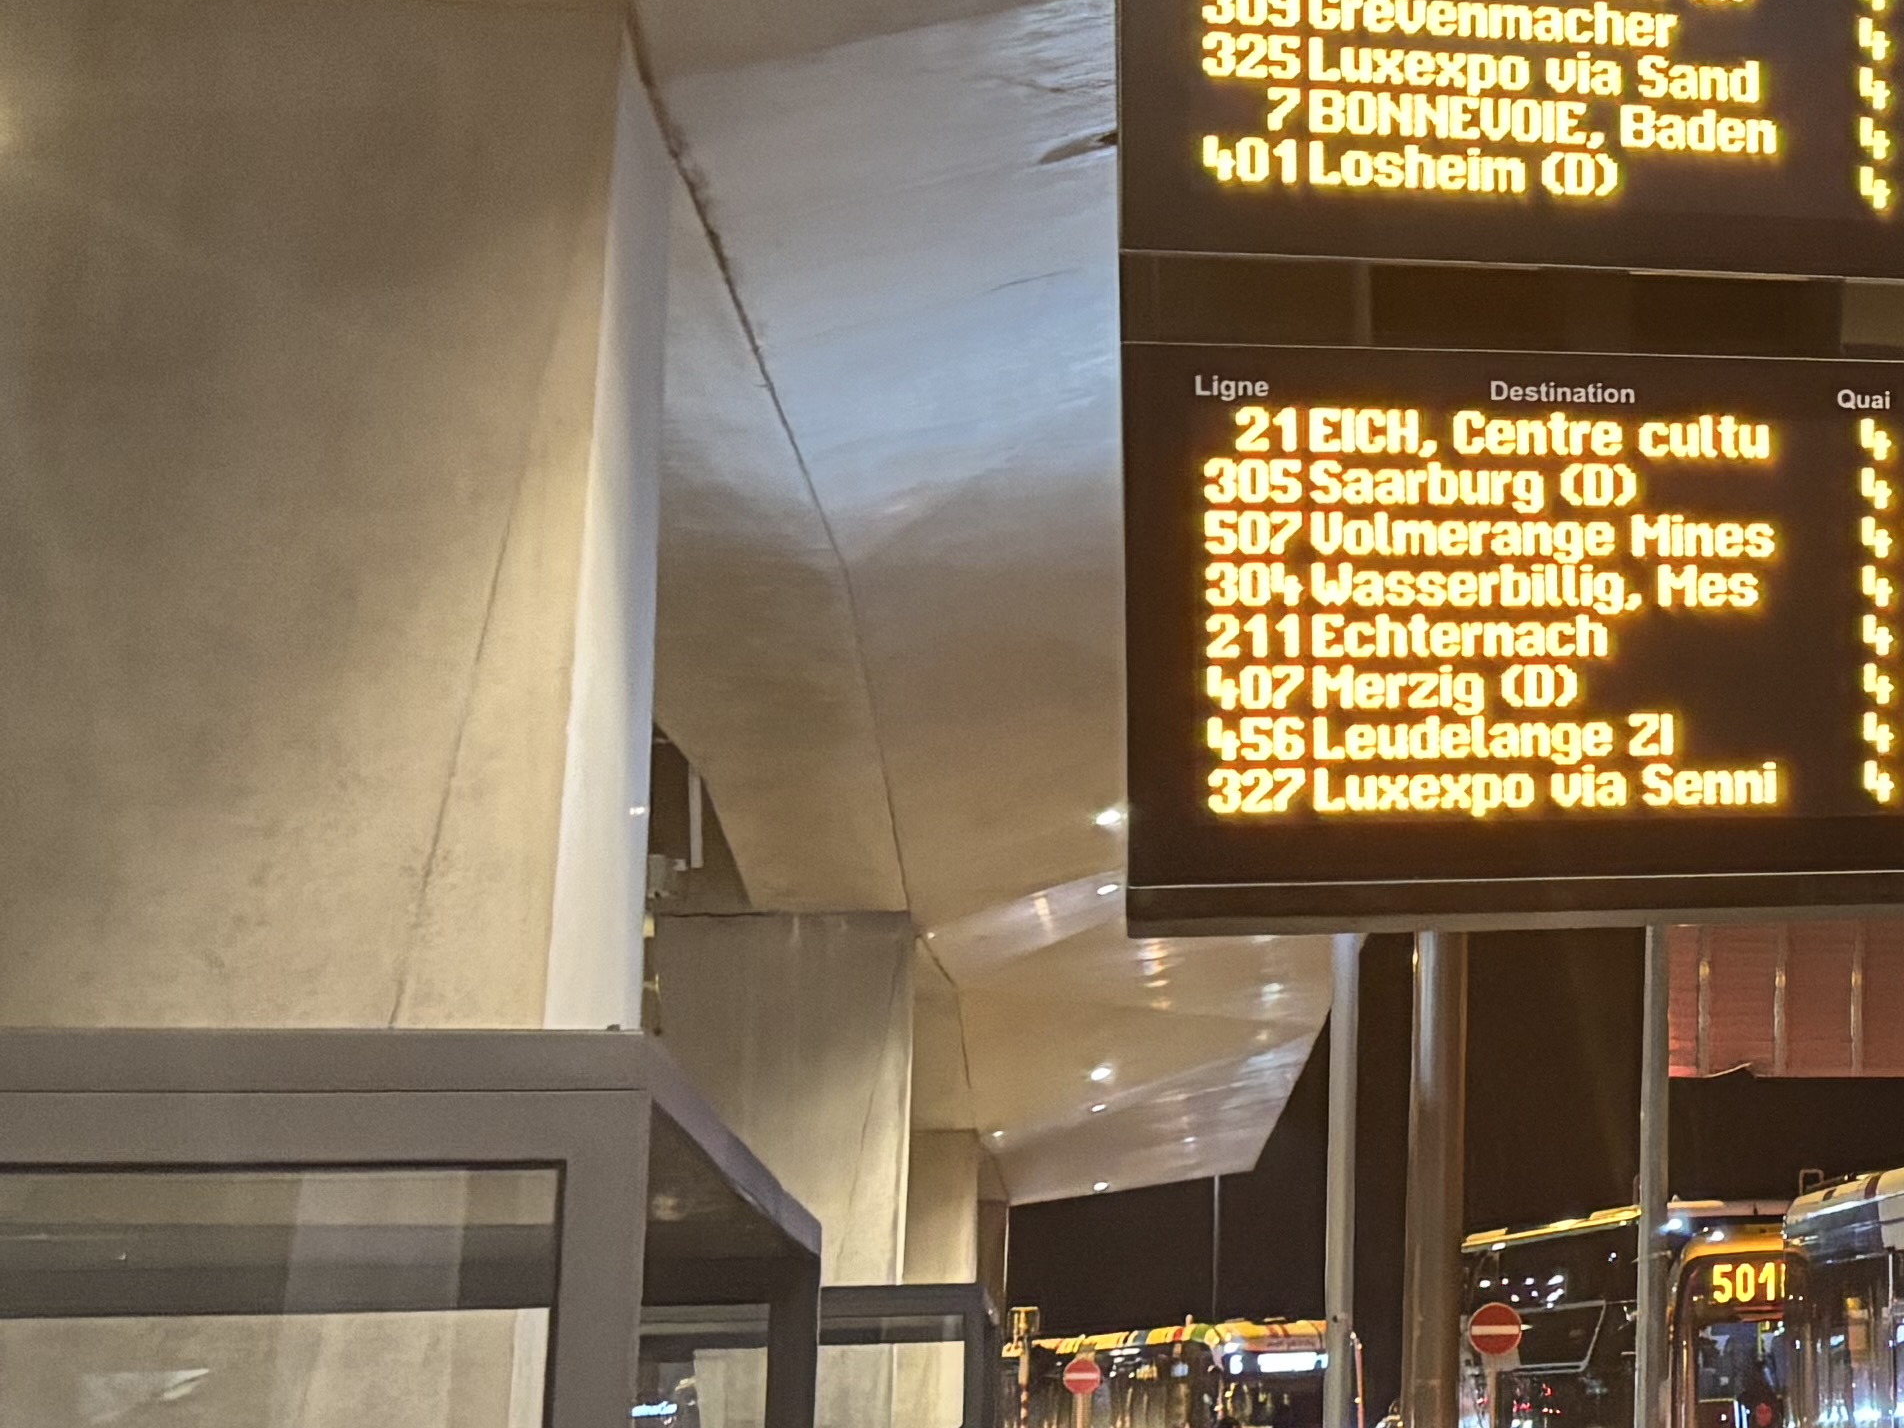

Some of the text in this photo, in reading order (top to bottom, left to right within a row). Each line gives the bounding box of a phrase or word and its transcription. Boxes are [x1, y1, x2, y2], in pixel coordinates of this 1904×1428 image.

[1858, 17, 1891, 61] 4
[1202, 31, 1301, 80] 325
[1308, 36, 1530, 97] Luxexpo
[1545, 51, 1622, 96] via
[1637, 54, 1760, 104] Sand
[1859, 66, 1891, 110] 4
[1267, 86, 1301, 131] 7
[1308, 89, 1605, 150] BONNEVOIE,
[1620, 104, 1777, 155] Baden
[1859, 116, 1891, 160] 4
[1202, 135, 1297, 184] 401
[1308, 140, 1526, 193] Losheim
[1541, 151, 1618, 197] (D)
[1860, 166, 1891, 209] 4
[1194, 374, 1270, 402] Ligne
[1489, 378, 1636, 407] Destination
[1836, 388, 1891, 411] Quai
[1235, 406, 1297, 452] 21
[1309, 407, 1438, 458] EICH,
[1452, 410, 1623, 456] Centre
[1638, 415, 1770, 459] cultu
[1860, 418, 1892, 461] 4
[1203, 457, 1303, 504] 305
[1309, 459, 1545, 514] Saarburg
[1560, 463, 1637, 507] (D)
[1861, 467, 1893, 510] 4
[1204, 510, 1303, 555] 507
[1310, 511, 1616, 565] Volmerange
[1631, 514, 1775, 558] Mines
[1861, 516, 1893, 559] 4
[1205, 562, 1304, 607] 304
[1310, 562, 1642, 615] Wasserbillig,
[1657, 564, 1759, 607] Mes
[1862, 565, 1894, 607] 4
[1205, 613, 1300, 659] 211
[1311, 613, 1608, 658] Echternach
[1862, 614, 1894, 656] 4
[1206, 665, 1305, 710] 407
[1312, 664, 1485, 716] Merzig
[1501, 664, 1578, 708] (D)
[1863, 663, 1895, 705] 4
[1206, 716, 1306, 761] 456
[1312, 715, 1613, 765] Leudelange
[1628, 713, 1674, 757] ZI
[1863, 712, 1895, 753] 4
[1207, 767, 1306, 814] 327
[1313, 767, 1535, 817] Luxexpo
[1550, 764, 1627, 808] via
[1642, 761, 1777, 806] Senni
[1863, 760, 1895, 802] 4
